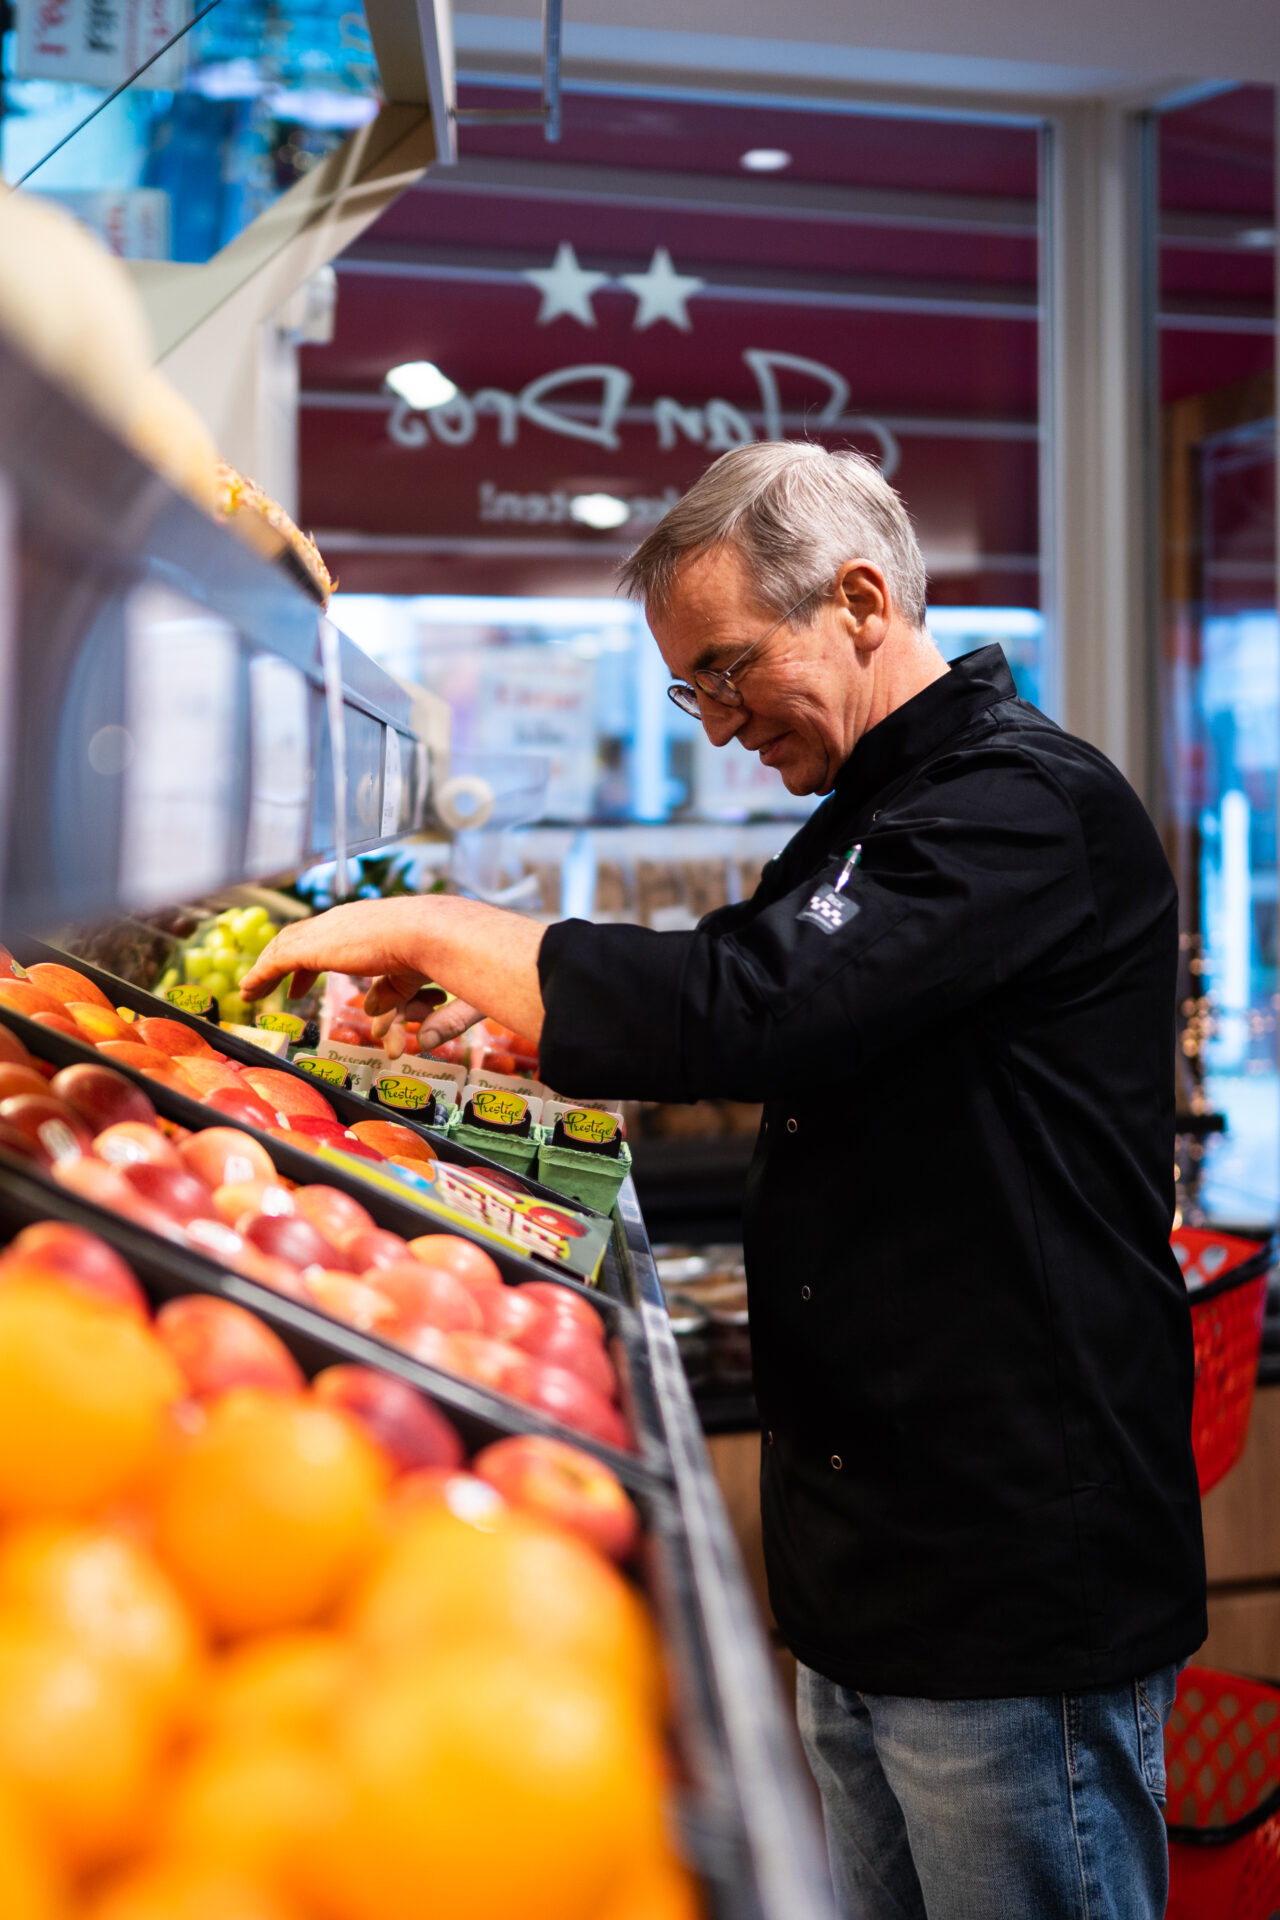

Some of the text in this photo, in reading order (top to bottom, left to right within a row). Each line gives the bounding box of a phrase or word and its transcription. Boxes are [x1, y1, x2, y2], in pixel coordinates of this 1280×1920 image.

[377, 1079, 430, 1109] Prestige
[472, 1093, 526, 1125] Prestige
[562, 1112, 617, 1143] Prestige
